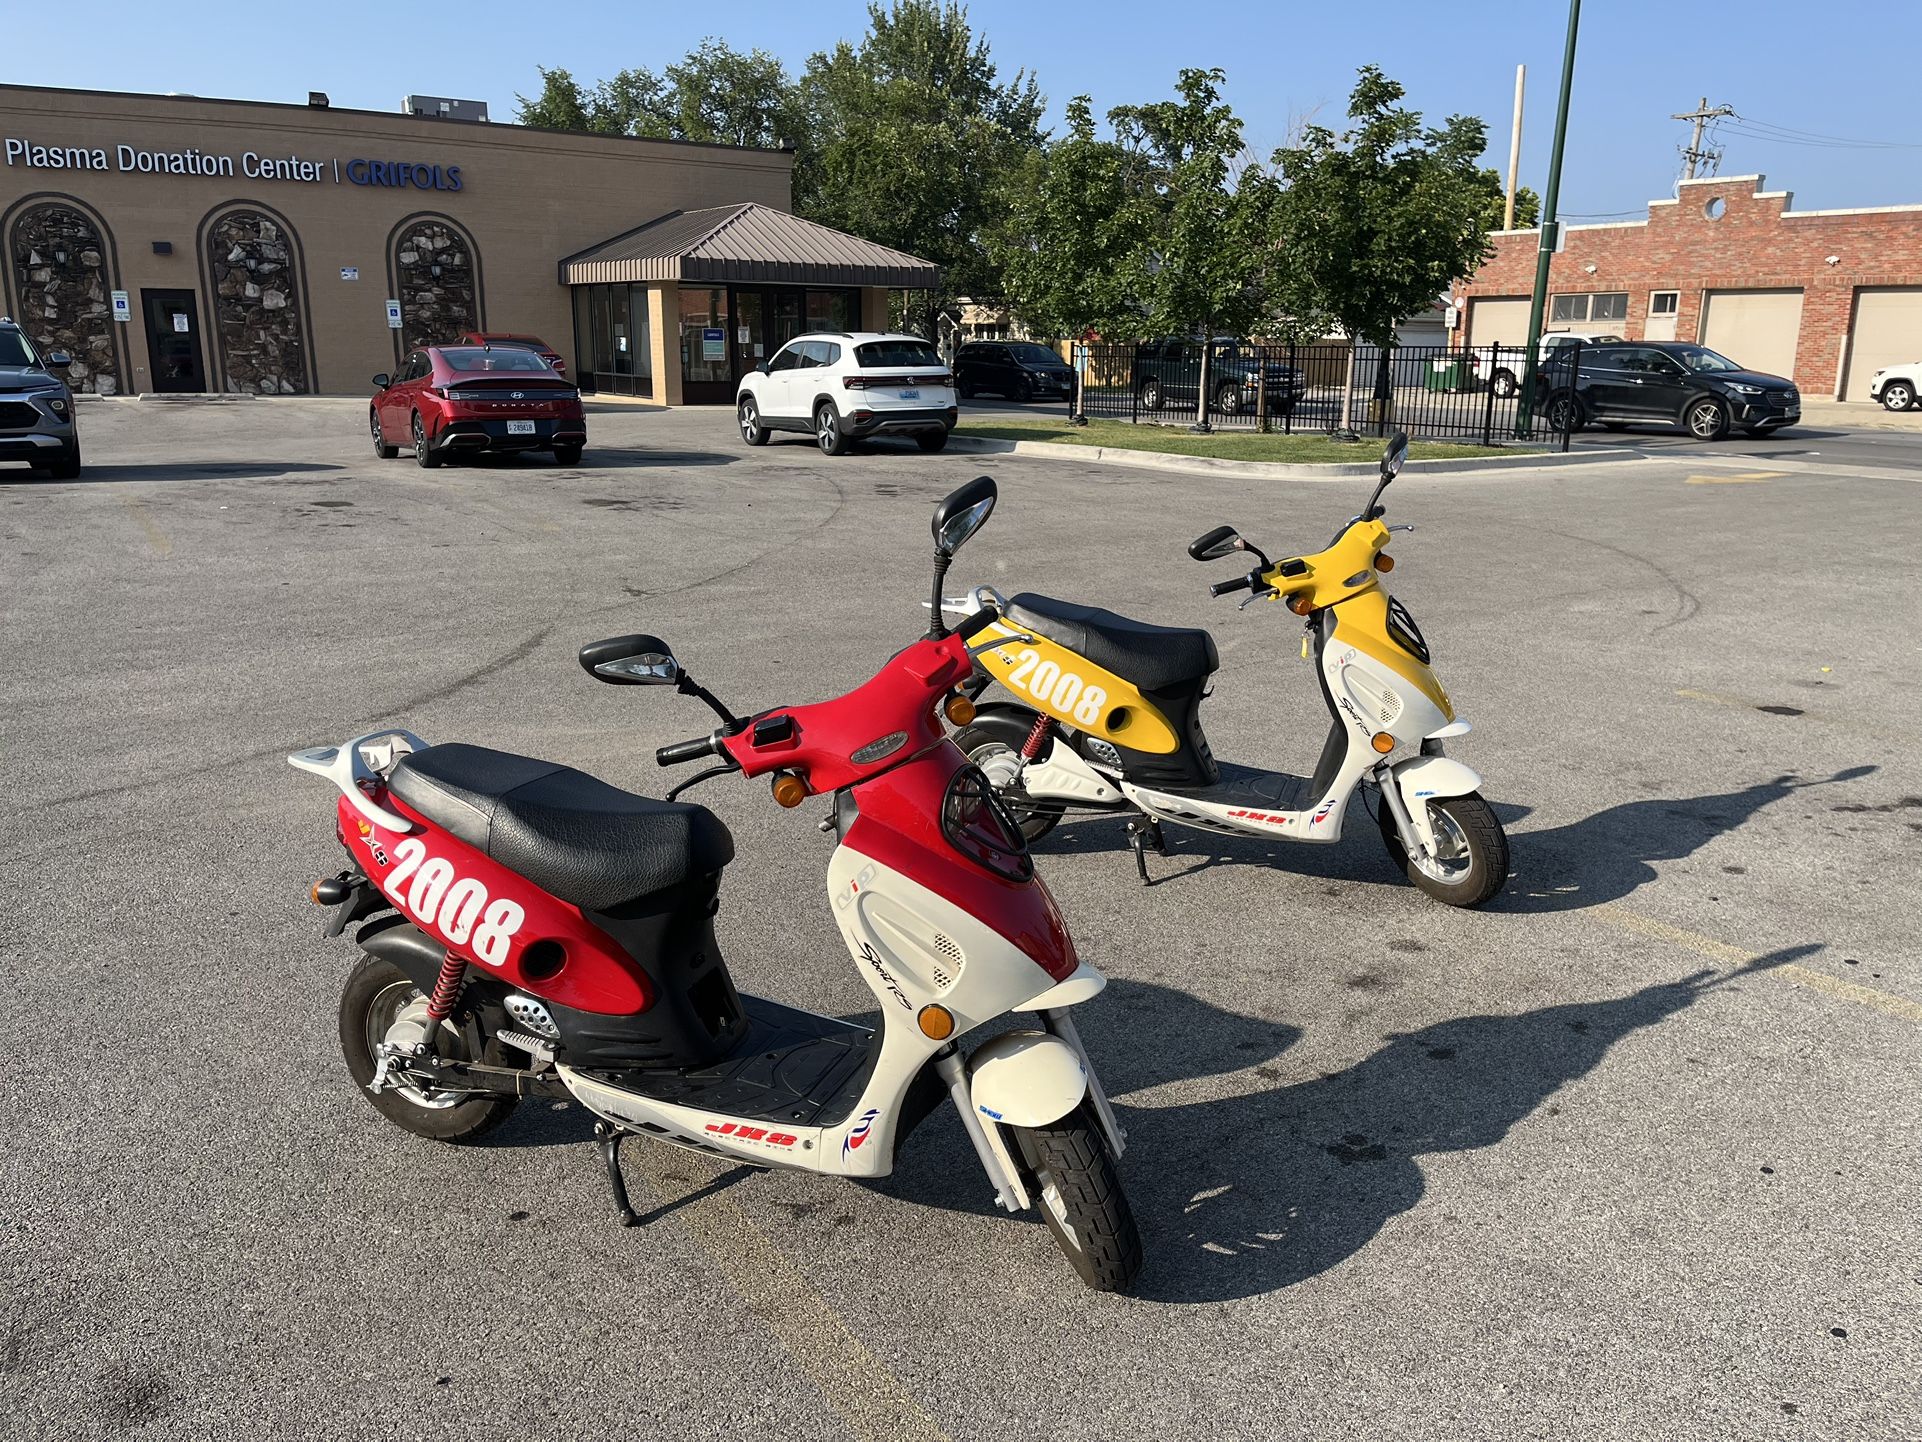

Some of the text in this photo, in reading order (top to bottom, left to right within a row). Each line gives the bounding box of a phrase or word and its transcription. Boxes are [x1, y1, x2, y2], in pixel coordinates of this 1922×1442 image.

[4, 138, 464, 192] Plasma Donation Center GRIFOLS
[1007, 648, 1108, 726] 2008
[383, 838, 525, 967] 2008
